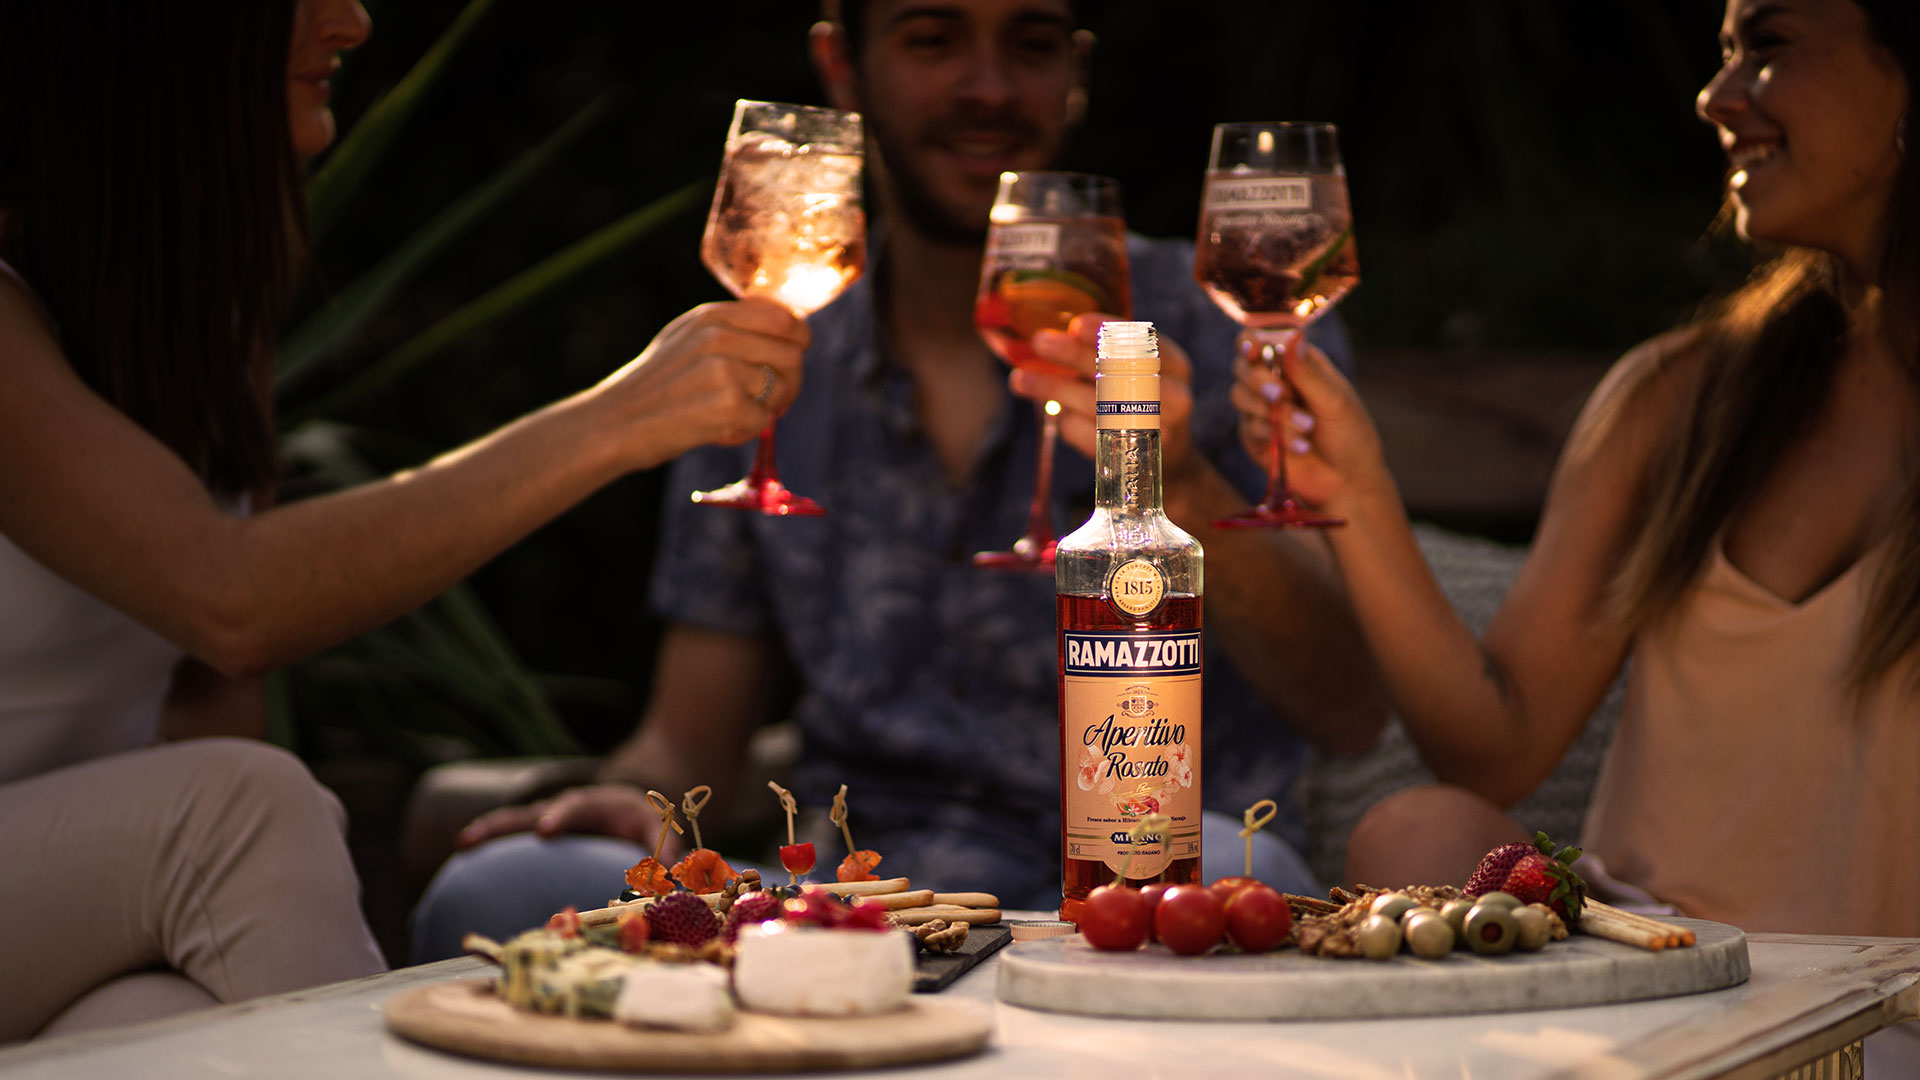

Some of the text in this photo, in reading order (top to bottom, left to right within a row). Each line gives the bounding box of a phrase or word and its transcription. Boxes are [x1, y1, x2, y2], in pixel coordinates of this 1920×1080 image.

[1120, 404, 1159, 413] RAMAZZOTTI
[1124, 580, 1153, 595] 1815
[1068, 638, 1199, 667] RAMAZZOTTI
[1083, 714, 1185, 756] Aperitivo
[1106, 752, 1169, 781] Rosato
